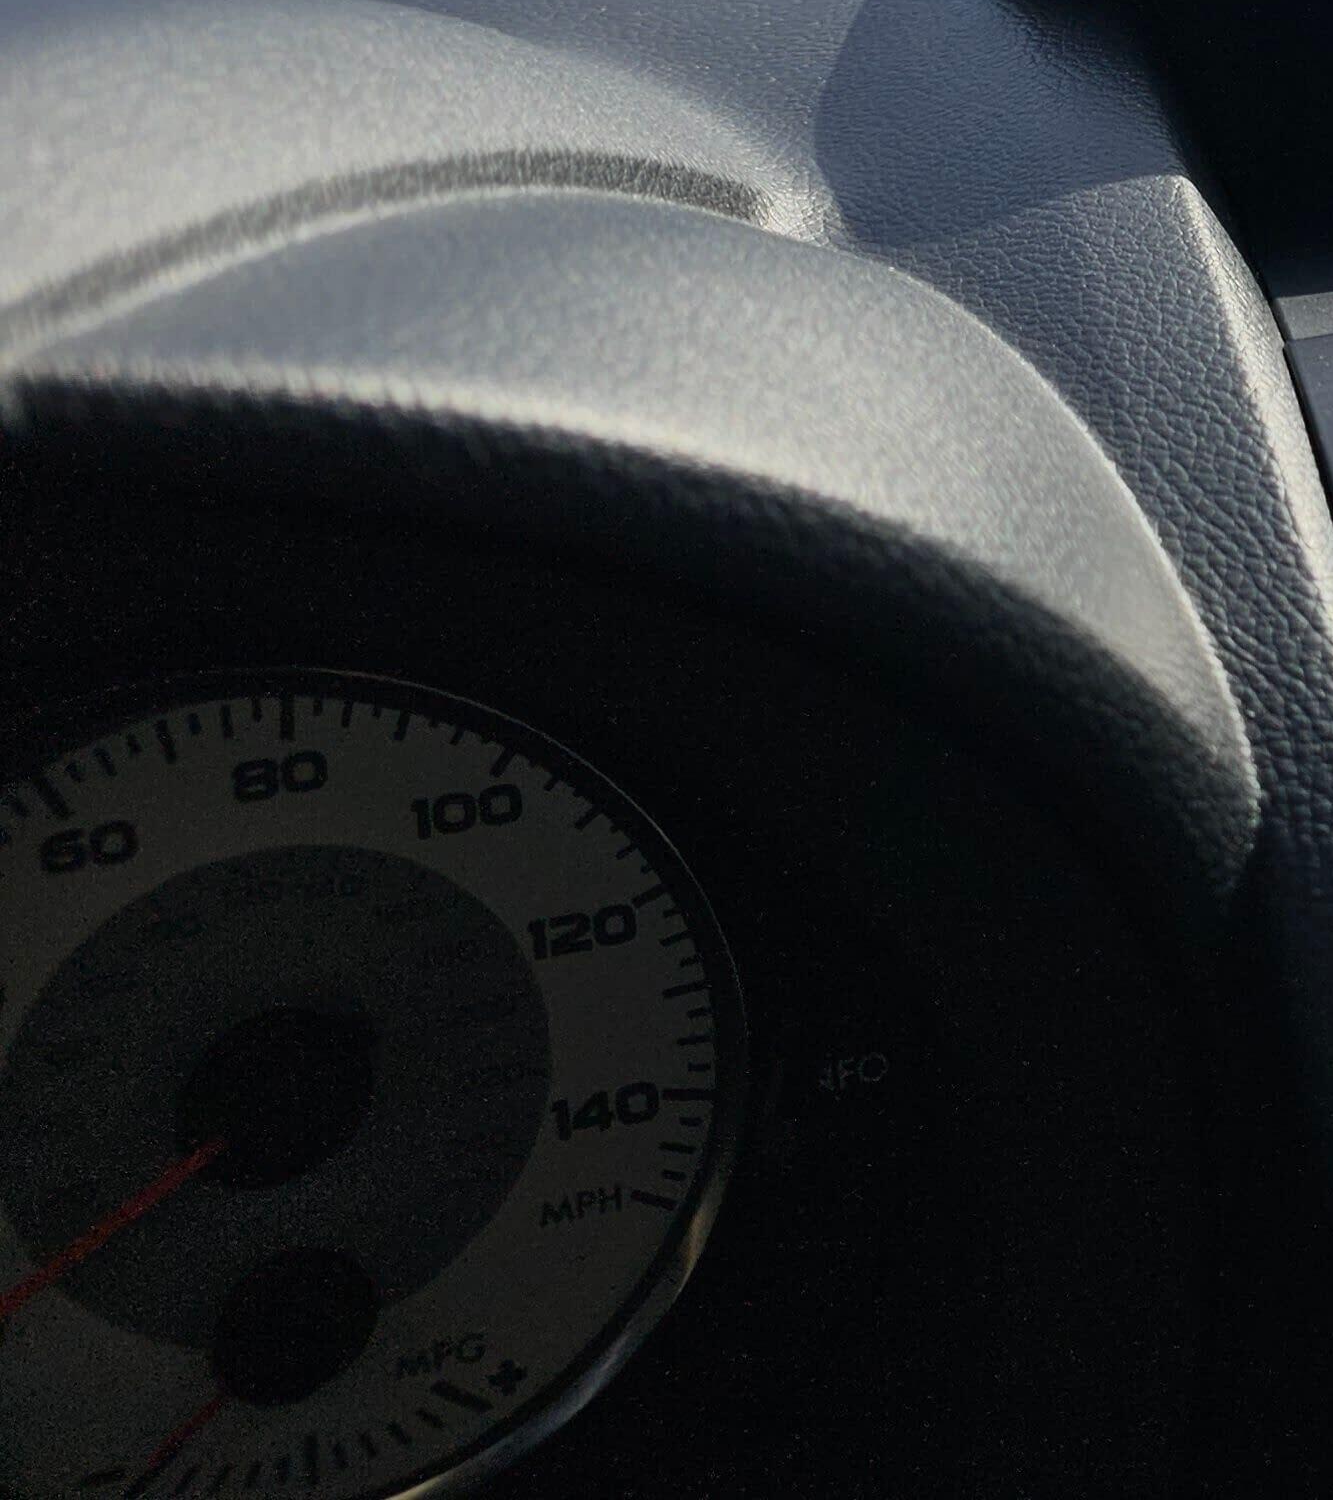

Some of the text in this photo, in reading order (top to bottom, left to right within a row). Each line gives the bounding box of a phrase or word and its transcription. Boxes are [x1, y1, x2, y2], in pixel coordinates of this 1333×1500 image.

[231, 749, 328, 804] 80
[411, 783, 524, 840] 100
[38, 819, 140, 875] 60
[527, 901, 639, 961] 120
[550, 1080, 662, 1141] 140
[538, 1183, 624, 1228] MPH
[398, 1332, 487, 1377] MPG
